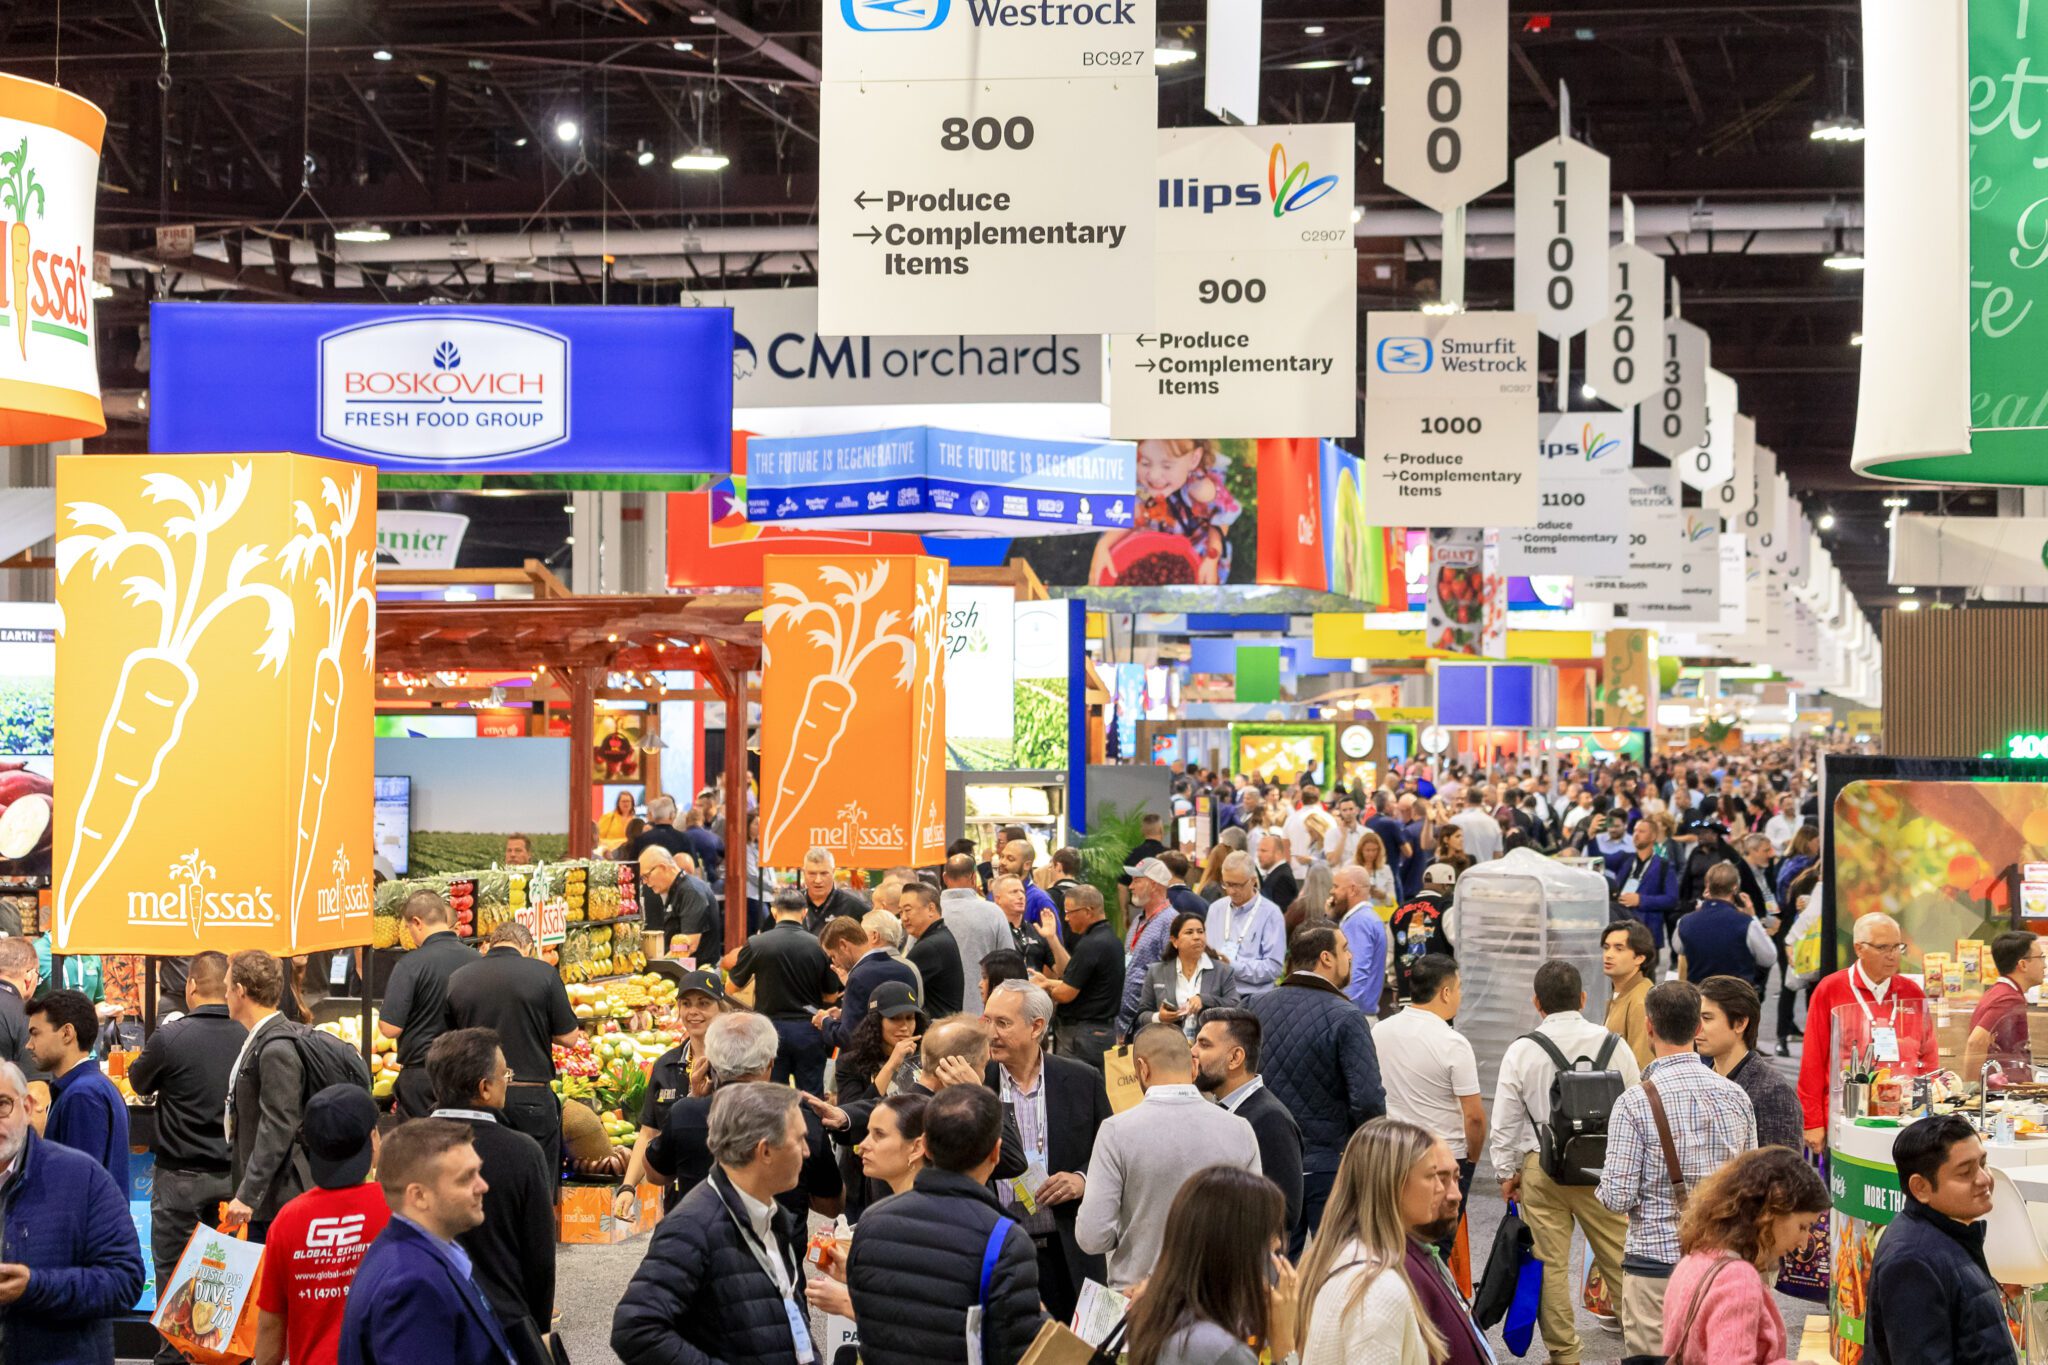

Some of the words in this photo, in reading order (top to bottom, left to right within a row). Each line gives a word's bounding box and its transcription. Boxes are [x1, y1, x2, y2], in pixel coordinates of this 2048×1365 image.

[967, 0, 1136, 27] Westrock
[1083, 51, 1145, 66] BC927
[940, 116, 1035, 151] 800
[887, 188, 1011, 212] Produce
[163, 228, 188, 239] FIRE
[885, 222, 1127, 250] Complementary
[1301, 230, 1346, 241] C2907
[1548, 161, 1574, 310] 1100
[885, 254, 970, 275] Items
[1198, 278, 1267, 303] 900
[1613, 262, 1634, 384] 1200
[1159, 332, 1249, 348] Produce
[1442, 338, 1516, 354] Smurfit
[768, 332, 870, 380] CMI
[882, 334, 1081, 378] orchards
[1158, 356, 1334, 376] Complementary
[1442, 357, 1527, 372] Westrock
[345, 372, 543, 394] BOSKOVICH
[1158, 379, 1219, 394] Items
[1663, 334, 1682, 438] 1300
[345, 411, 409, 427] FRESH
[416, 411, 469, 427] FOOD
[476, 411, 544, 427] GROUP
[1421, 417, 1482, 434] 1000
[755, 452, 775, 475] THE
[779, 449, 818, 474] FUTURE
[823, 449, 833, 471] IS
[837, 441, 915, 470] REGENERATIVE
[939, 443, 962, 468] THE
[968, 446, 1015, 474] FUTURE
[1020, 452, 1031, 475] IS
[1037, 453, 1125, 481] REGENERATIVE
[1400, 453, 1463, 465] Produce
[1399, 470, 1522, 484] Complementary
[1399, 485, 1442, 496] Items
[1542, 493, 1585, 506] 1100
[1630, 497, 1674, 506] estrock
[1526, 521, 1572, 530] oduce
[1524, 534, 1617, 544] Complementary
[1524, 546, 1557, 554] Items
[1, 630, 36, 641] EARTH
[128, 884, 274, 938] melissa's
[1864, 1184, 1887, 1210] MORE
[293, 1248, 334, 1260] GLOBAL
[194, 1280, 234, 1306] DIVE
[299, 1288, 311, 1299] +1
[314, 1286, 341, 1300] (470)
